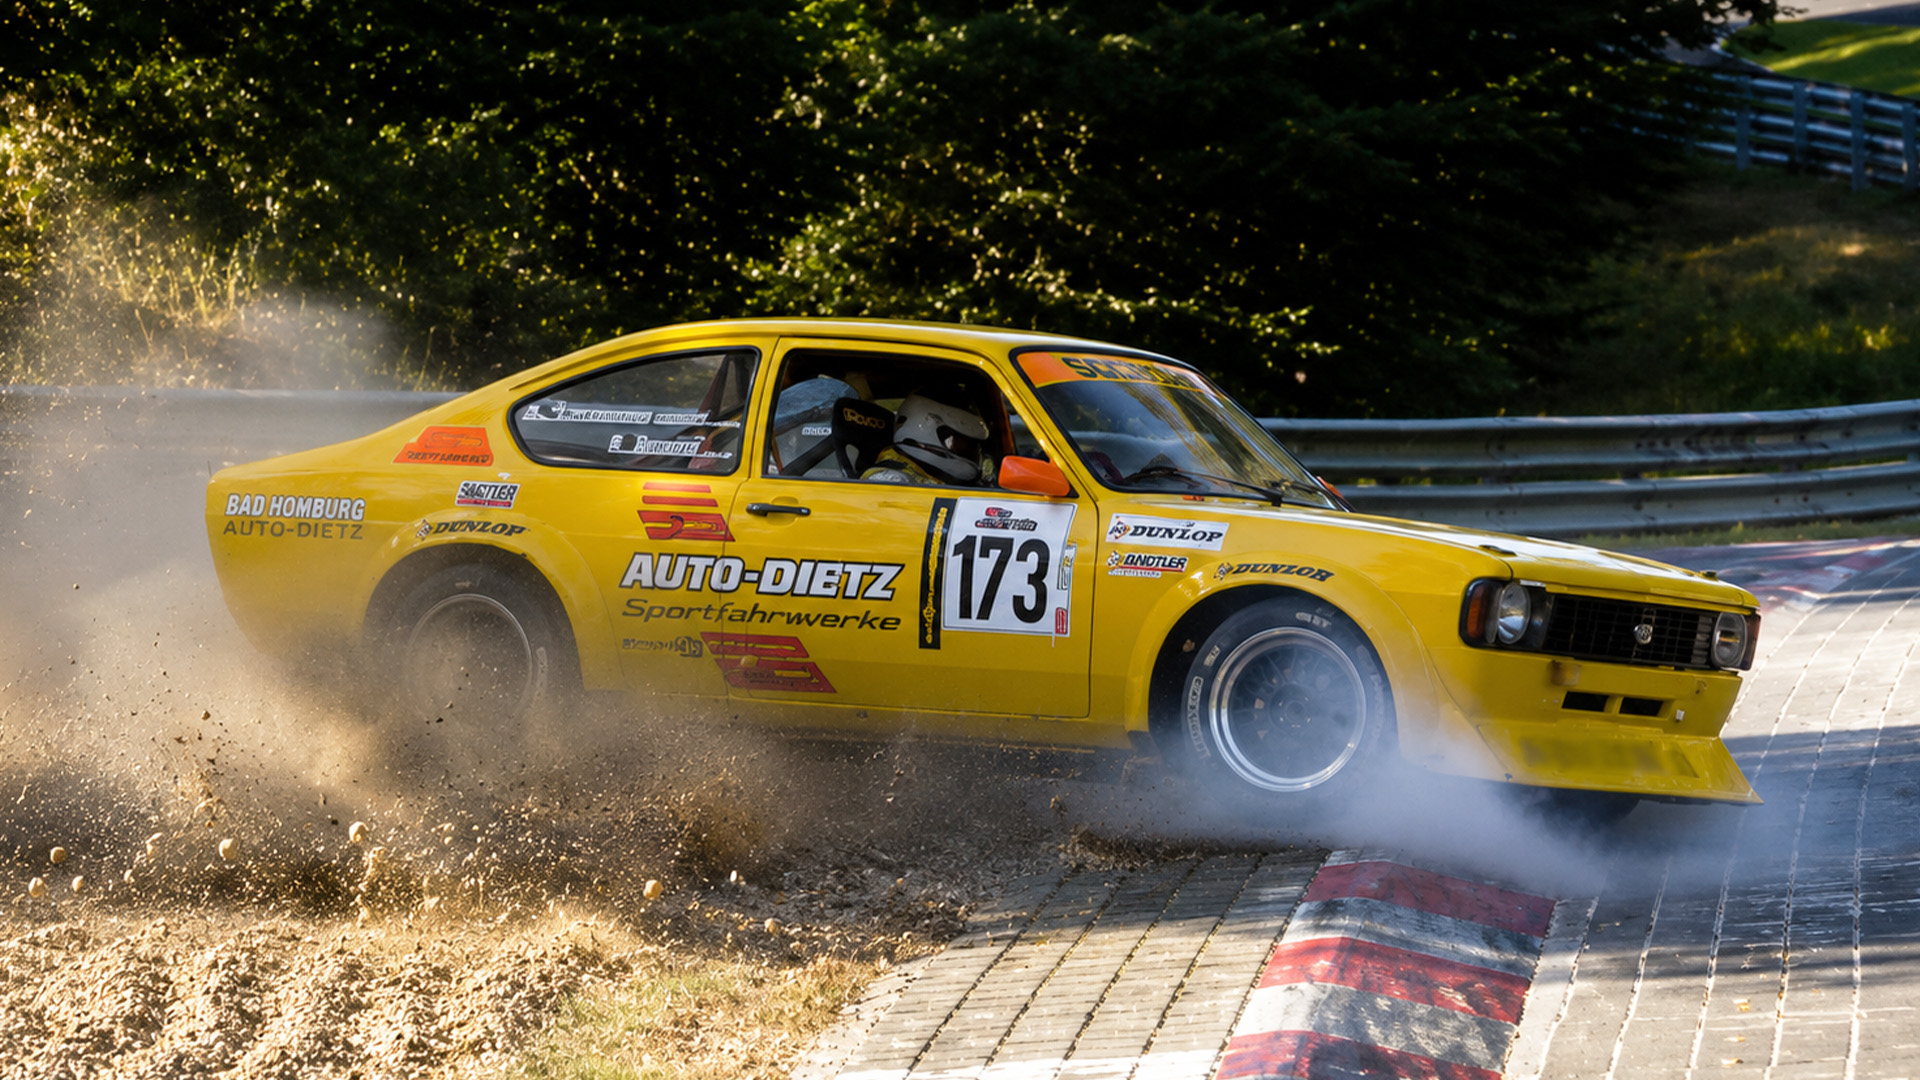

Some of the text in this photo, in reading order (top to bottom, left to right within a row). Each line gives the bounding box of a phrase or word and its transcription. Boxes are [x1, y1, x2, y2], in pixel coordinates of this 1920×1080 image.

[225, 493, 366, 521] BAD HOMBURG
[223, 519, 364, 540] AUTO-DIETZ
[433, 520, 526, 537] DUNLOP
[1129, 525, 1223, 542] DUNLOP
[619, 551, 905, 601] AUTO-DIETZ
[952, 535, 1050, 623] 173
[621, 598, 901, 631] Sportfahrwerke
